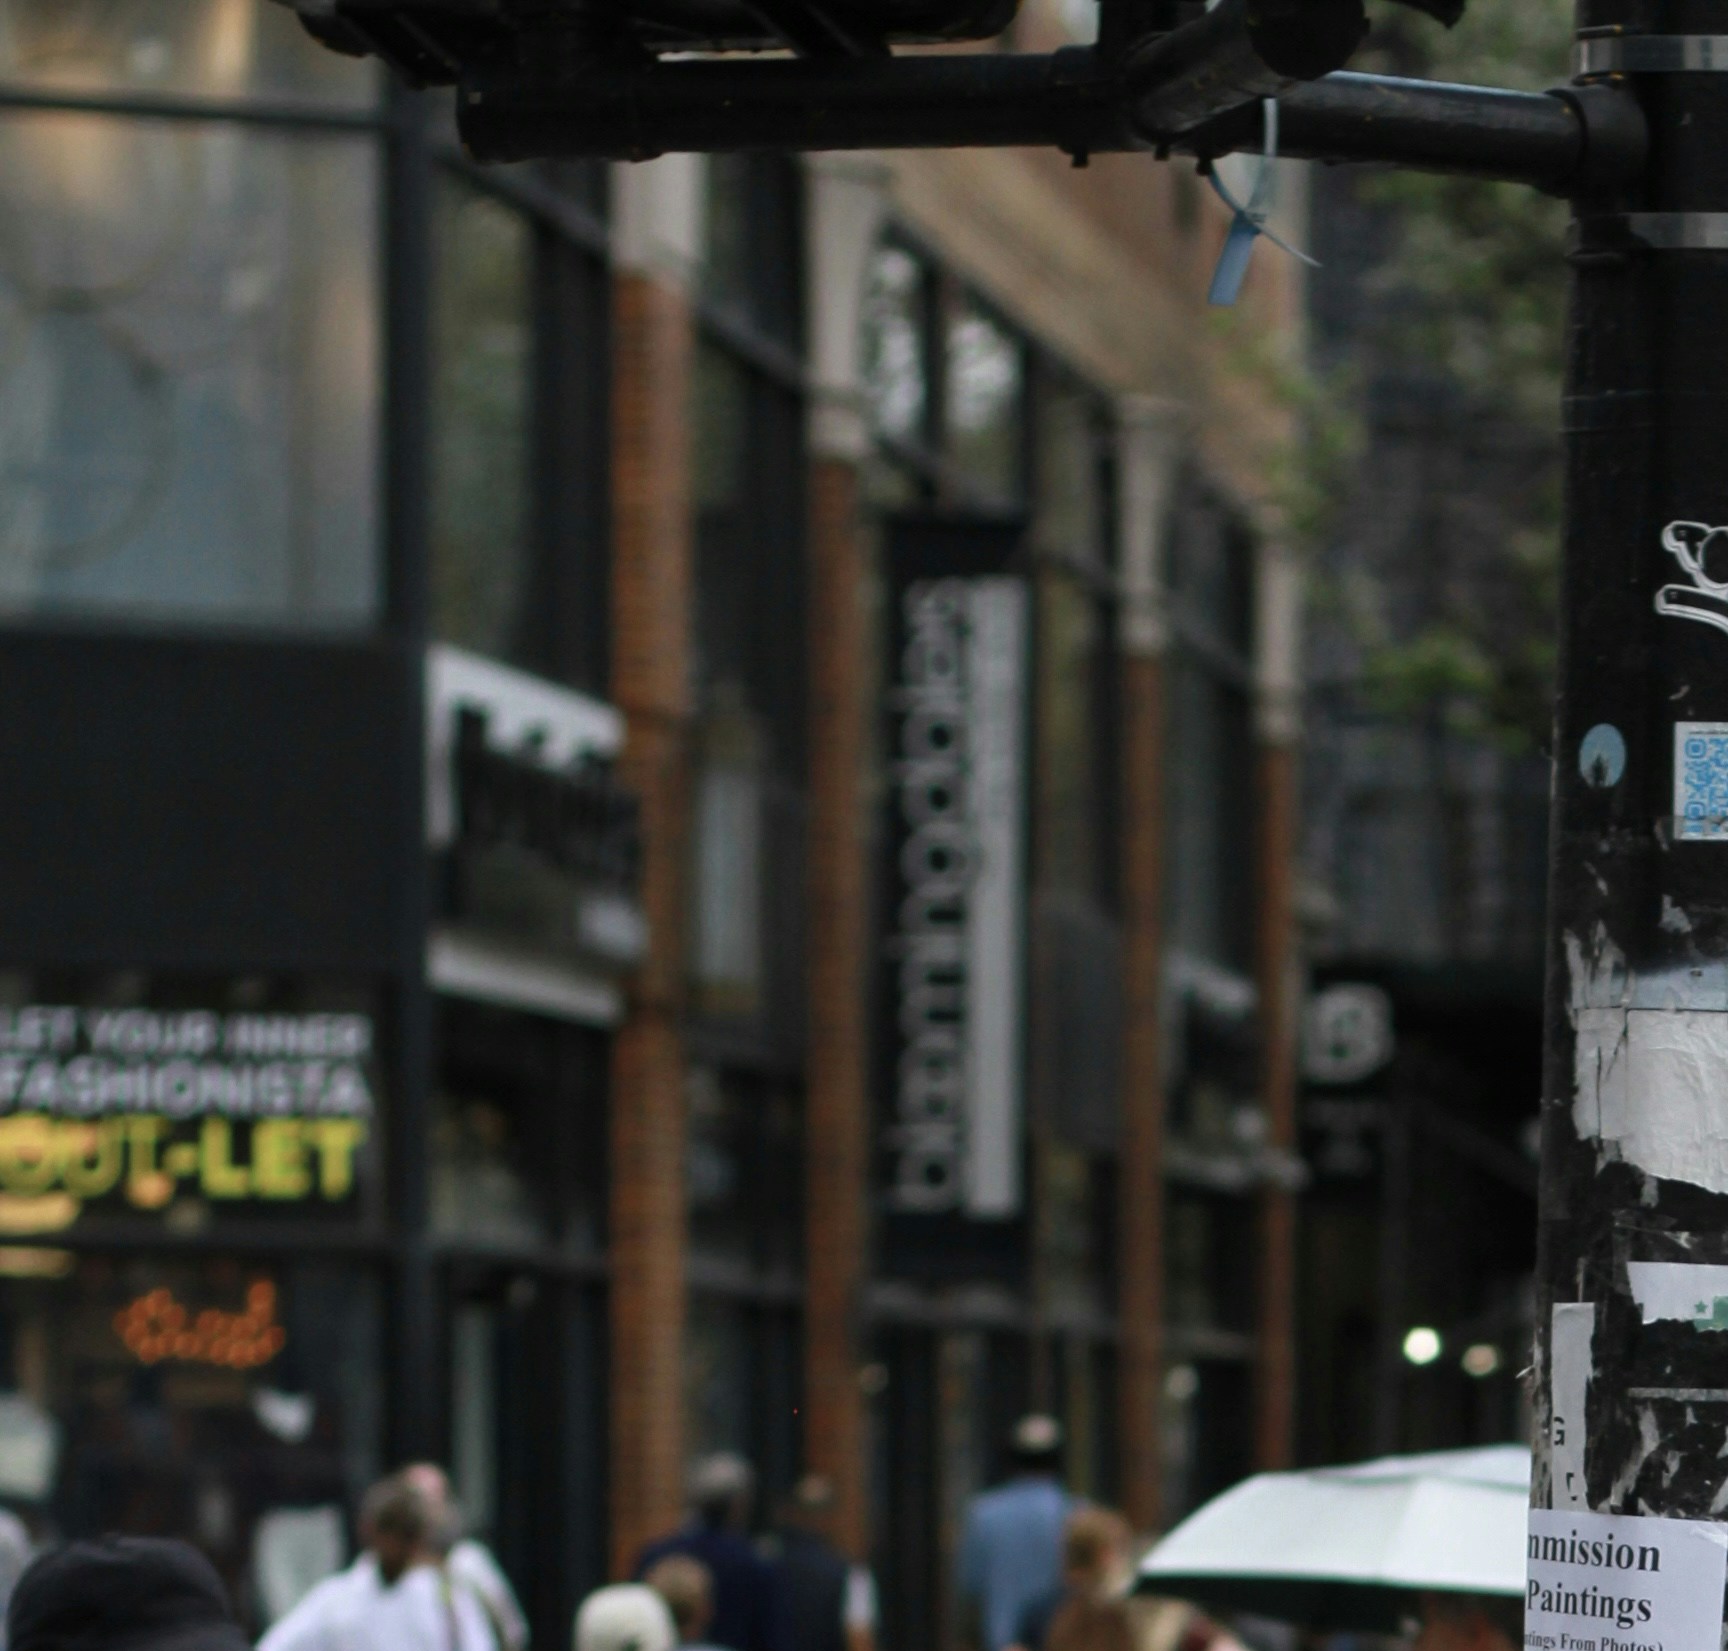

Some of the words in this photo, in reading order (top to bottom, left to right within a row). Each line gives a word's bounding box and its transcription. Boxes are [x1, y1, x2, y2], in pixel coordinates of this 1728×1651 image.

[84, 1007, 219, 1052] YOUR
[226, 1012, 373, 1054] INNER
[1527, 1579, 1652, 1629] Paintings
[1560, 1633, 1596, 1651] From
